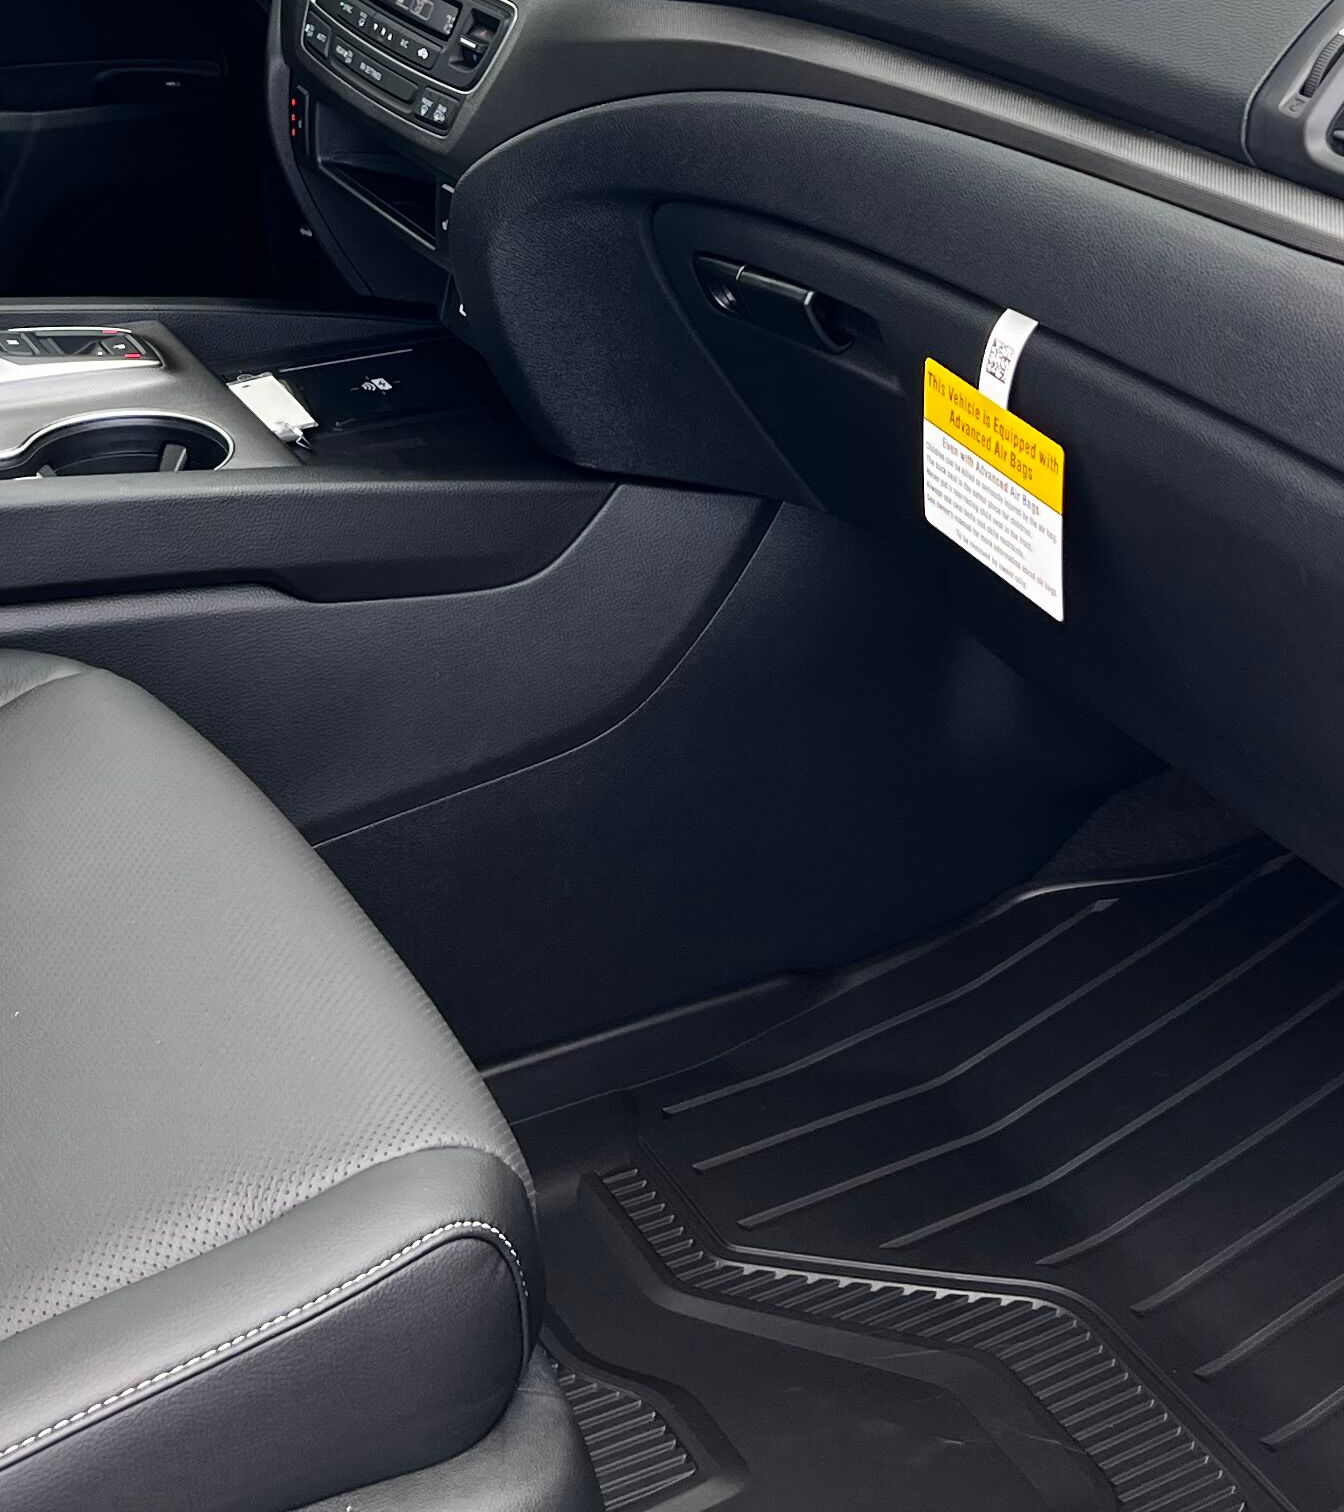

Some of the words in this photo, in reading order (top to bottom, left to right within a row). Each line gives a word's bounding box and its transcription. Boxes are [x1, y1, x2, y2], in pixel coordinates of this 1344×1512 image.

[927, 371, 945, 396] This
[948, 385, 980, 420] Vehicle
[982, 409, 990, 427] is
[993, 416, 1036, 463] Equipped
[1038, 448, 1059, 475] with
[949, 409, 991, 451] Advanced
[994, 441, 1007, 463] Air
[1010, 453, 1032, 483] Bags
[942, 436, 958, 456] Even
[959, 450, 973, 467] with
[975, 460, 1008, 492] Advanced
[1009, 485, 1020, 501] Air
[1022, 495, 1039, 517] Bags
